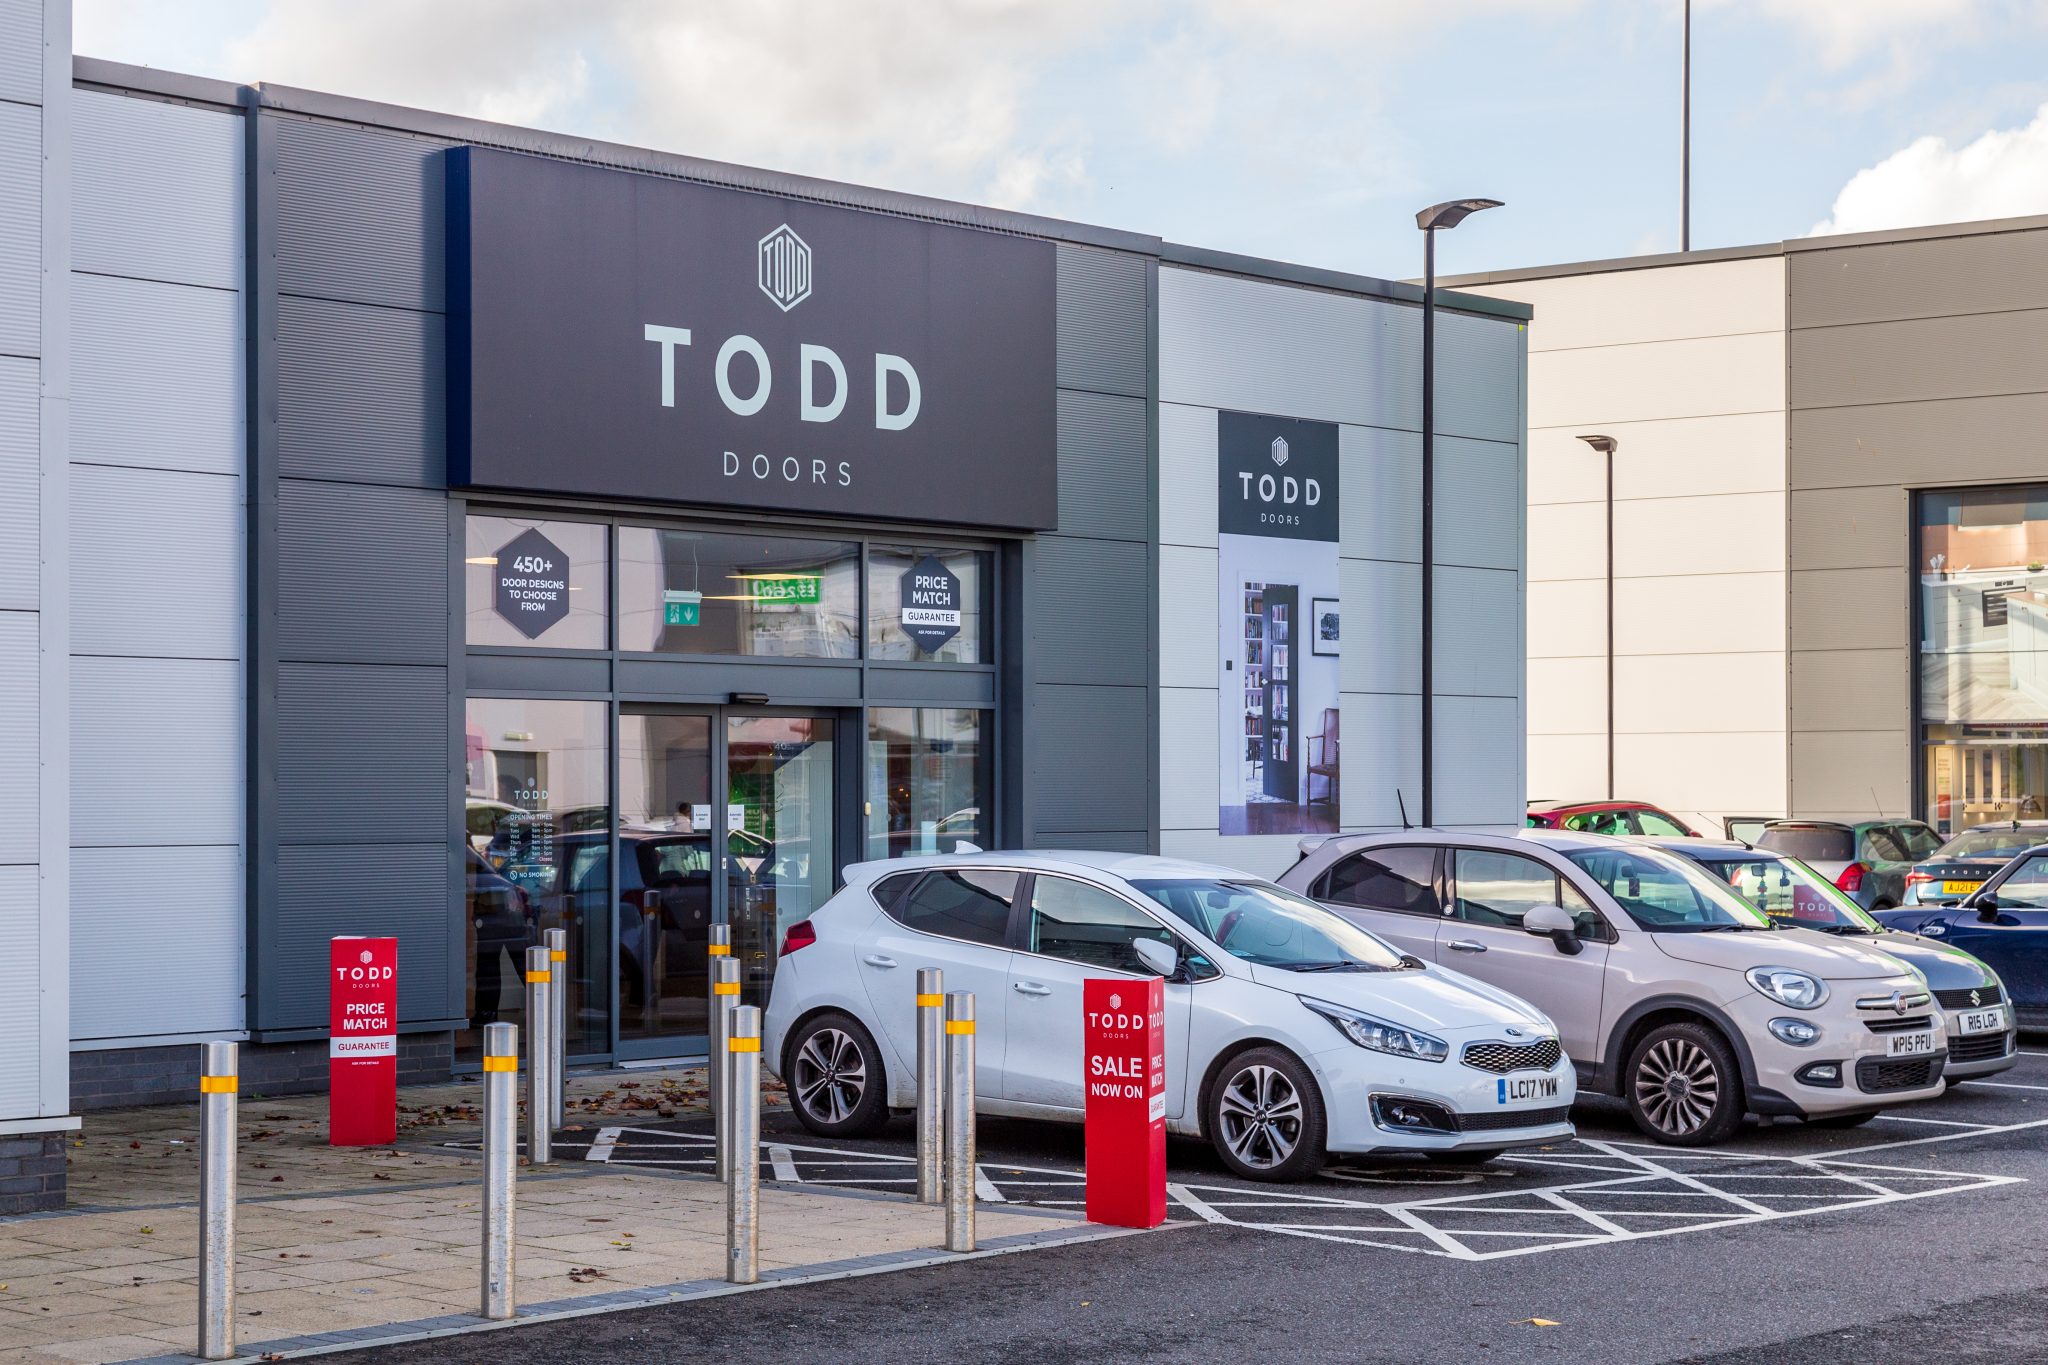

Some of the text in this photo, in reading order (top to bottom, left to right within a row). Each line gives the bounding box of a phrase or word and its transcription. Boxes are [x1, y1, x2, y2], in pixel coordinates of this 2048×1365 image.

[644, 323, 922, 431] TODD
[723, 451, 852, 487] DOORS
[1239, 471, 1321, 506] TODD
[1261, 513, 1300, 525] DOORS
[513, 556, 553, 573] 450+
[502, 578, 564, 590] DOOR DESIGNS
[915, 575, 948, 590] PRICE
[509, 590, 557, 600] TO CHOOSE
[912, 591, 951, 606] MATCH
[521, 602, 546, 611] FROM
[908, 612, 955, 622] GUARANTEE
[514, 790, 549, 800] TODD
[337, 966, 392, 981] TODD
[346, 1003, 385, 1015] PRICE
[343, 1018, 388, 1030] MATCH
[1089, 1012, 1144, 1030] TODD
[1968, 1014, 1982, 1031] R15
[338, 1041, 390, 1051] GUARANTEE
[1892, 1033, 1931, 1053] WP15 PFU
[1091, 1055, 1143, 1078] SALE
[1091, 1083, 1143, 1099] NOW ON
[1510, 1079, 1536, 1100] LC17
